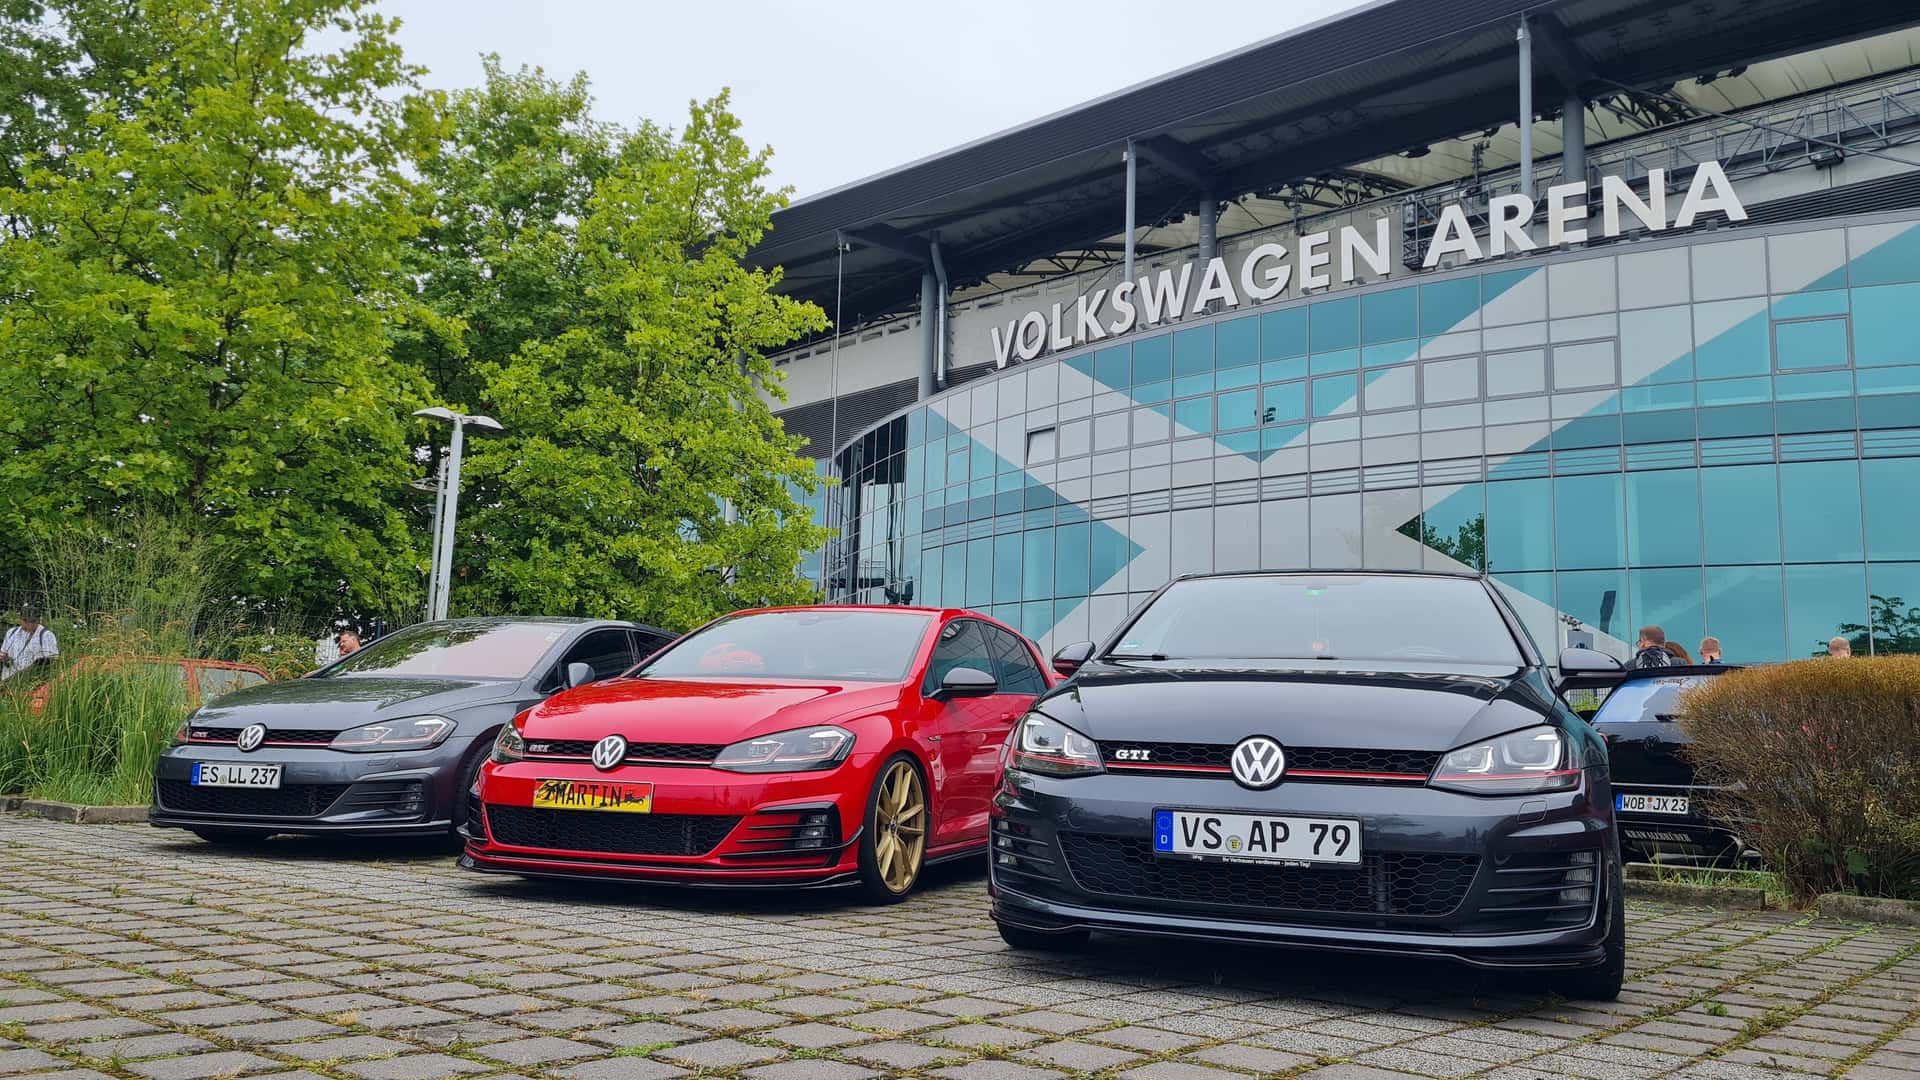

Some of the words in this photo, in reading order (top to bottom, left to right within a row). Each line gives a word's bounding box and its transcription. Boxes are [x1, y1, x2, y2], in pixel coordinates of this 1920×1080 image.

[991, 218, 1390, 370] VOLKSWAGEN
[1422, 161, 1749, 268] ARENA
[1115, 749, 1150, 761] GTI
[200, 767, 218, 784] ES
[228, 768, 246, 785] LL
[250, 768, 279, 786] 237
[554, 783, 622, 807] MARTIN
[1623, 796, 1645, 810] WOB
[1653, 797, 1668, 811] JX
[1671, 798, 1687, 812] 23
[1160, 834, 1168, 844] D
[1181, 816, 1222, 850] VS
[1247, 820, 1290, 853] AP
[1309, 823, 1351, 857] 79
